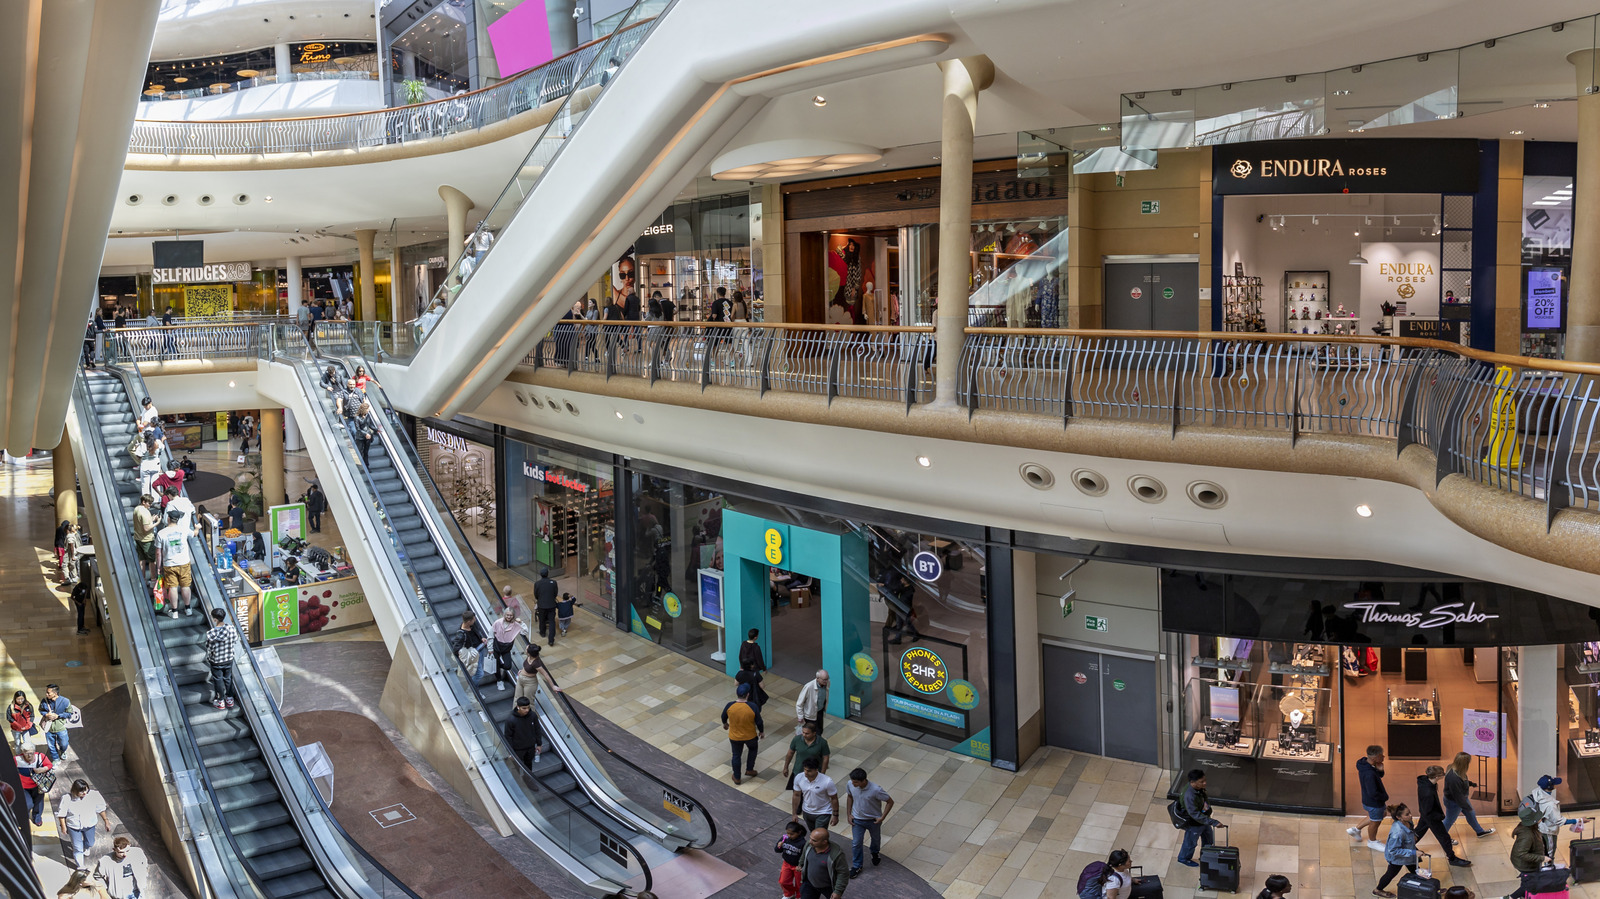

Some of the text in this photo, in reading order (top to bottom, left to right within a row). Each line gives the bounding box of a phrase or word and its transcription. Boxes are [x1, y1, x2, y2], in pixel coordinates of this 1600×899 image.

[300, 52, 331, 61] Fumo
[1260, 158, 1387, 177] ENDURA ROSES
[641, 224, 674, 236] EIGER
[1380, 262, 1434, 275] ENDURA
[1535, 298, 1554, 307] 20%
[1534, 307, 1555, 316] OFF
[427, 426, 469, 453] MISS DIVA
[523, 461, 545, 481] kids
[919, 560, 935, 574] BT
[340, 595, 364, 609] good!
[275, 593, 293, 634] BOOST
[1343, 602, 1499, 628] Thomas Sabo
[906, 650, 941, 667] PHONES
[912, 664, 935, 678] 2HR
[905, 671, 943, 692] REPAIRED
[971, 739, 990, 751] BIG
